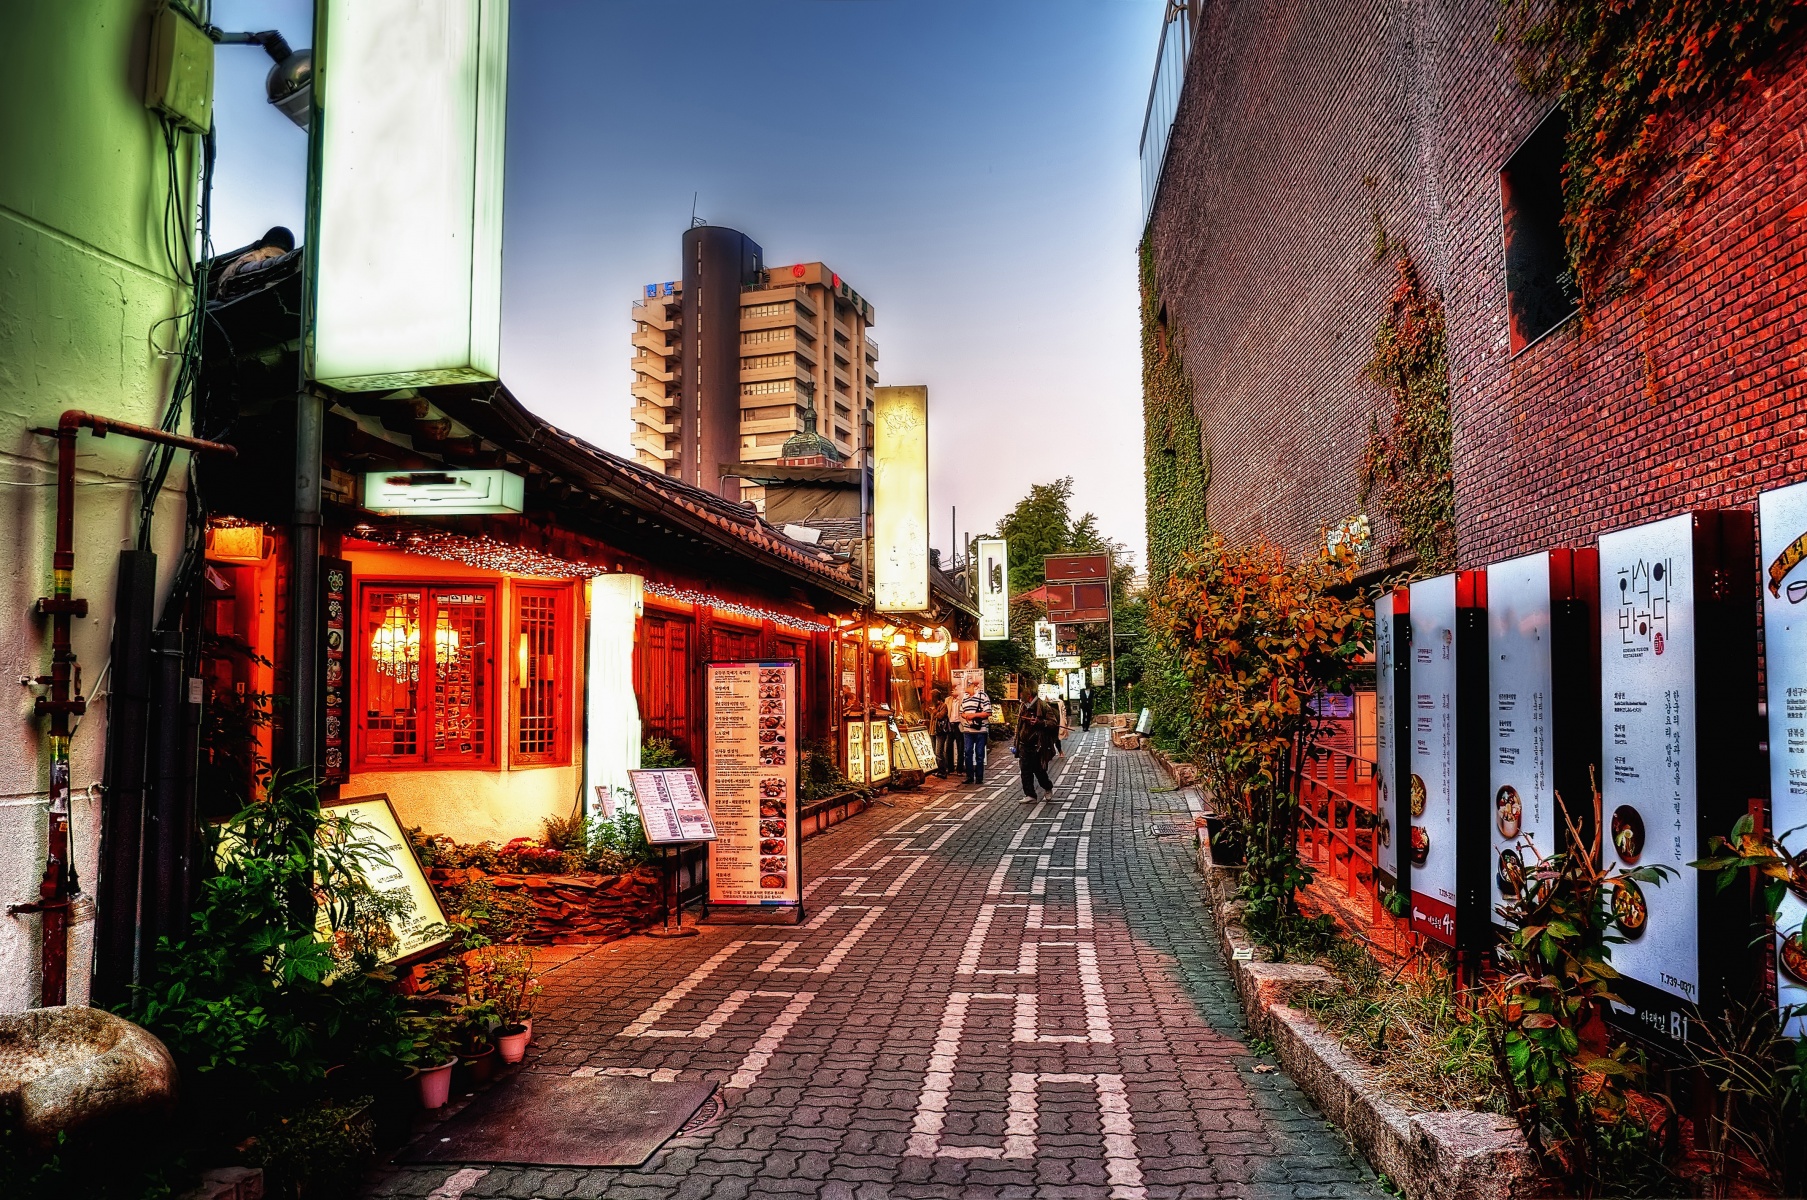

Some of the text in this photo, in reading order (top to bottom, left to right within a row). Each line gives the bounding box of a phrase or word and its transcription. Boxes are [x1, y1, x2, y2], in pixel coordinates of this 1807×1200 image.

[1617, 557, 1672, 608] 한식에
[1618, 597, 1671, 645] 반하다
[1442, 913, 1454, 936] 4F
[1670, 1010, 1688, 1044] B1
